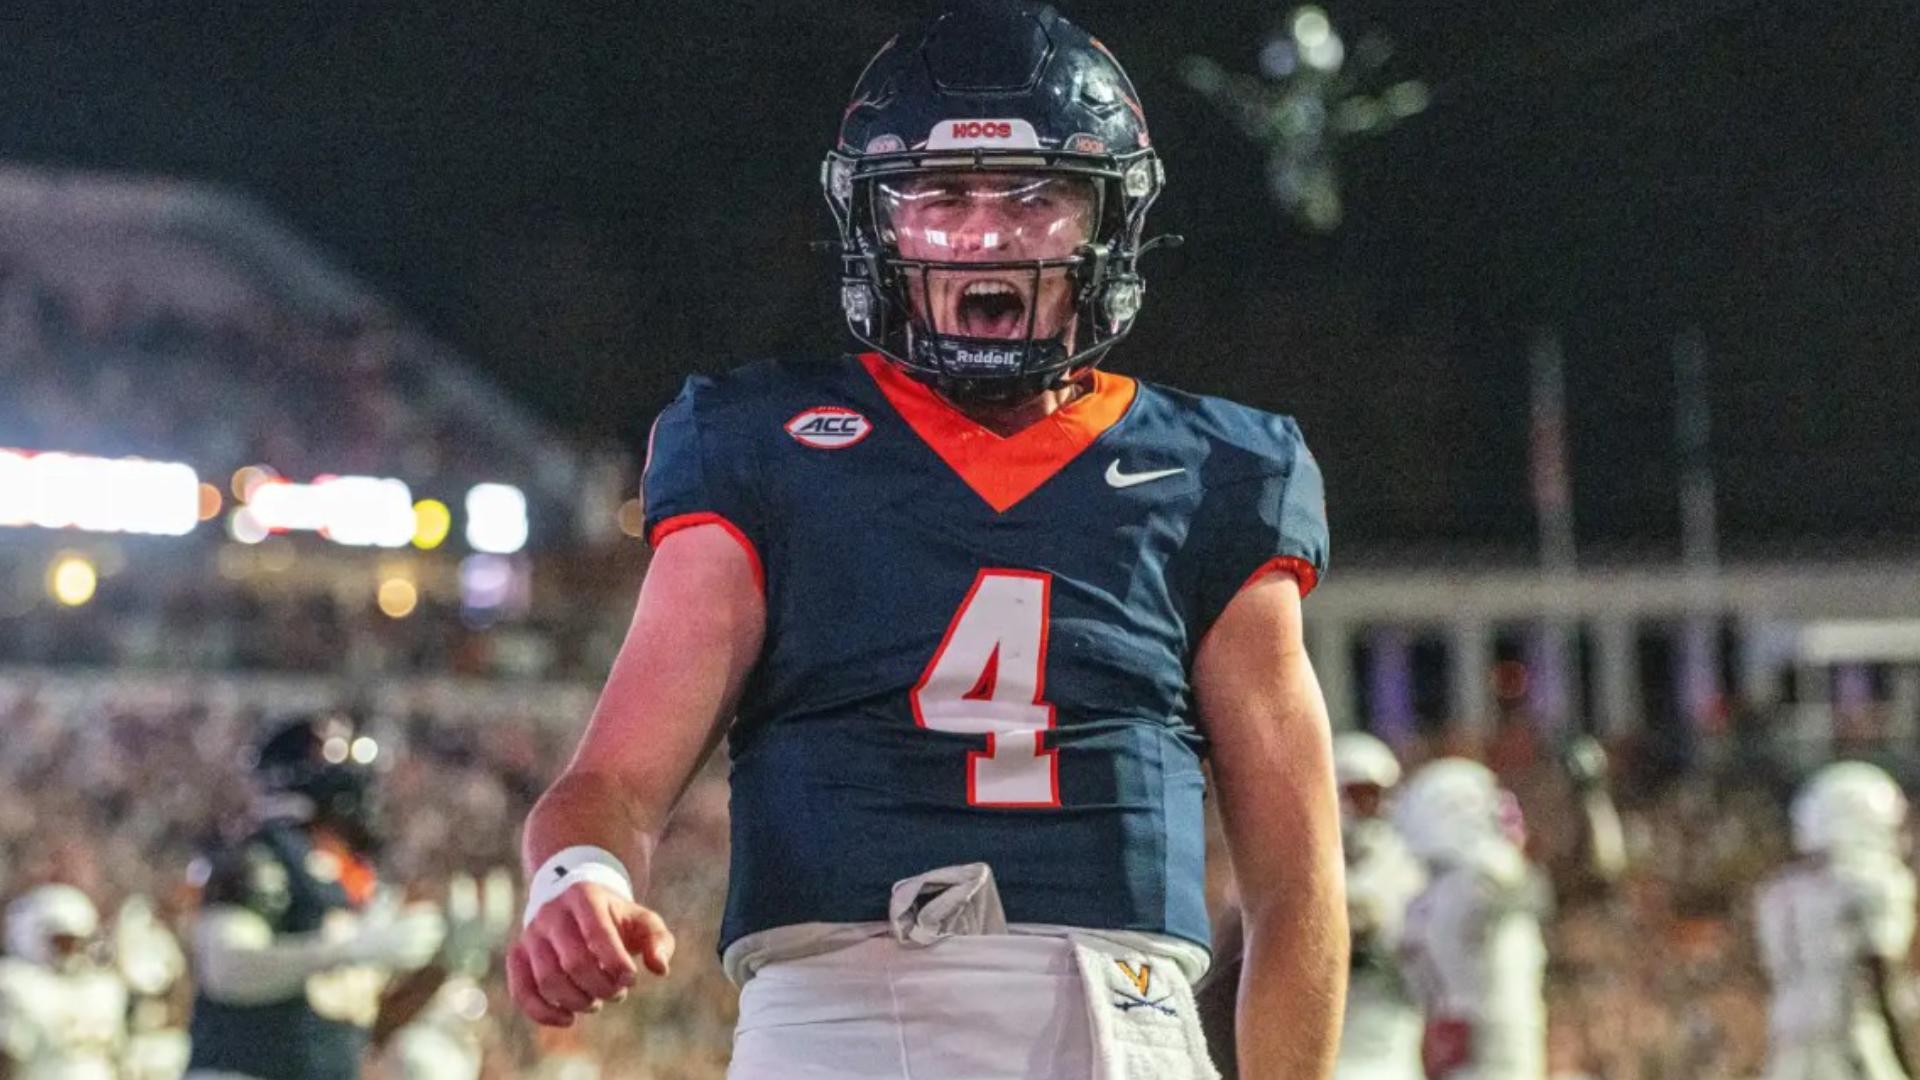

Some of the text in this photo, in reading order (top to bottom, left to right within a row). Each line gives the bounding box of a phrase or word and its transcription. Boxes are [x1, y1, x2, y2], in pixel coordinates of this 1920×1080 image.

[952, 122, 1012, 138] HOOS
[956, 350, 1016, 365] Riddell
[800, 416, 860, 433] ACC
[909, 567, 1061, 808] 4
